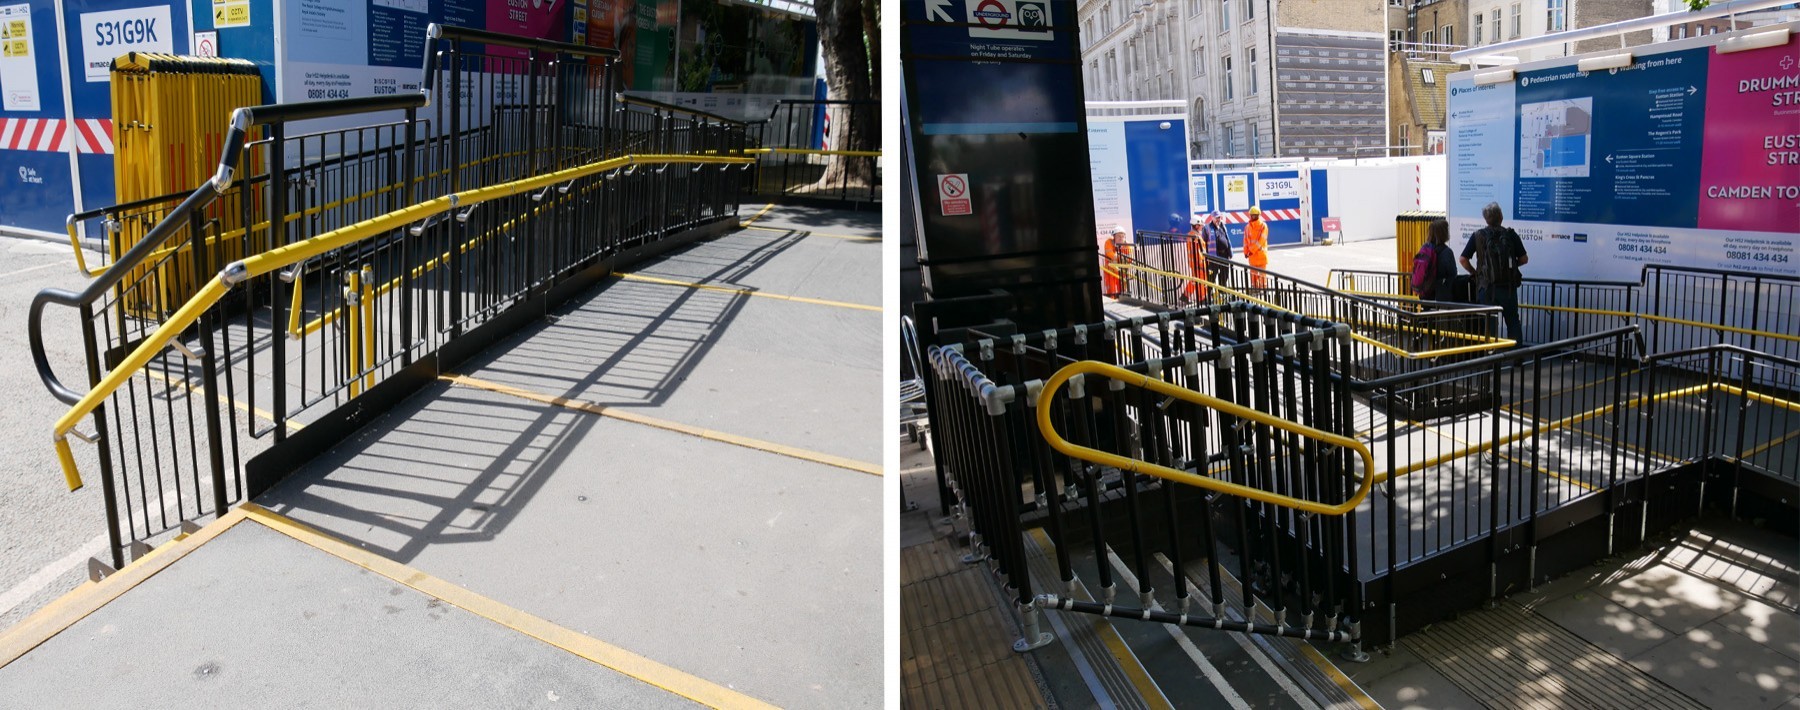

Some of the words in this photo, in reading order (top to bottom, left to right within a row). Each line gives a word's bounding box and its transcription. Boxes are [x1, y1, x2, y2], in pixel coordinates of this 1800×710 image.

[231, 8, 244, 16] CCTV
[509, 10, 528, 22] STREET
[95, 18, 158, 46] S31G9K
[1620, 62, 1646, 72] Walking
[1647, 58, 1664, 67] from
[1665, 56, 1682, 64] here
[1530, 74, 1558, 84] Pedestrian
[1559, 72, 1575, 81] route
[1738, 74, 1800, 93] DRUMM
[308, 89, 325, 99] 08081
[327, 89, 337, 99] 434
[339, 89, 349, 98] 434
[374, 86, 396, 94] EUSTON
[1708, 186, 1772, 198] CAMDEN
[1776, 186, 1800, 198] TO
[1619, 244, 1638, 252] 08081
[1726, 251, 1750, 260] 08081
[1753, 252, 1769, 261] 434
[1771, 254, 1788, 263] 434
